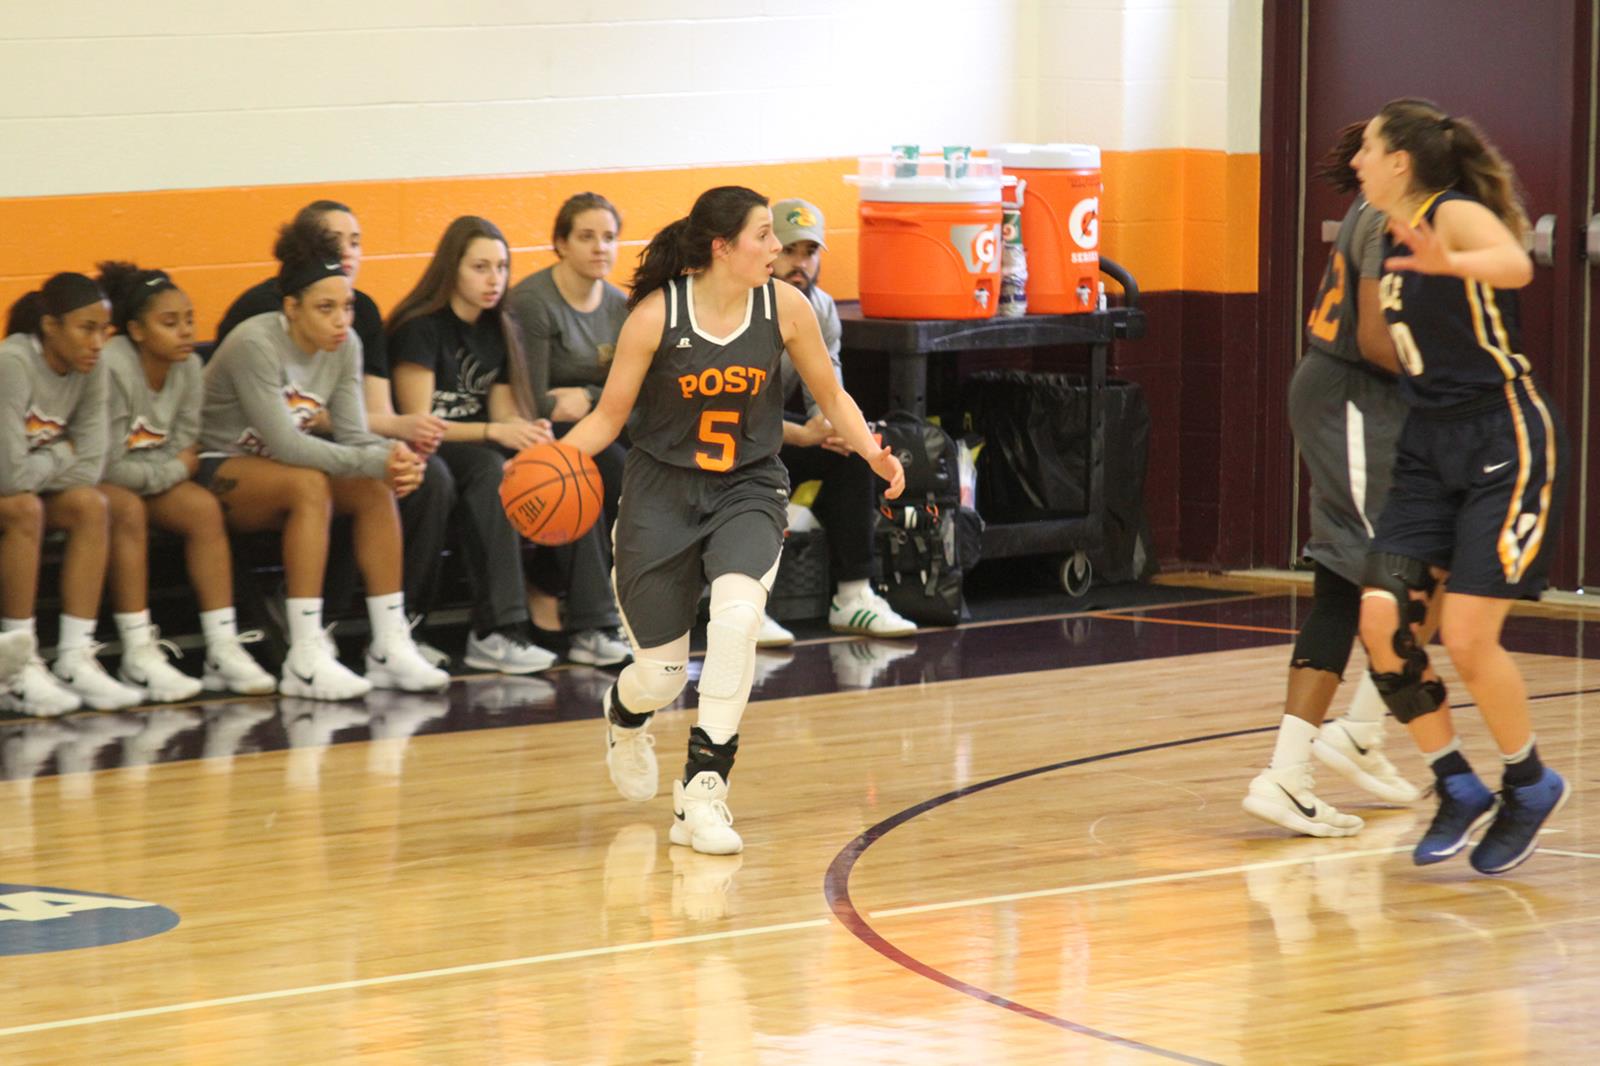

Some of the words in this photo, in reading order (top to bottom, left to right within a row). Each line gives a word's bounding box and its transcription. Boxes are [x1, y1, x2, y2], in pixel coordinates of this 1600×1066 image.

[976, 230, 995, 263] G
[1069, 197, 1098, 250] G
[1308, 251, 1345, 341] 2
[679, 366, 766, 399] POST
[695, 410, 740, 472] 5
